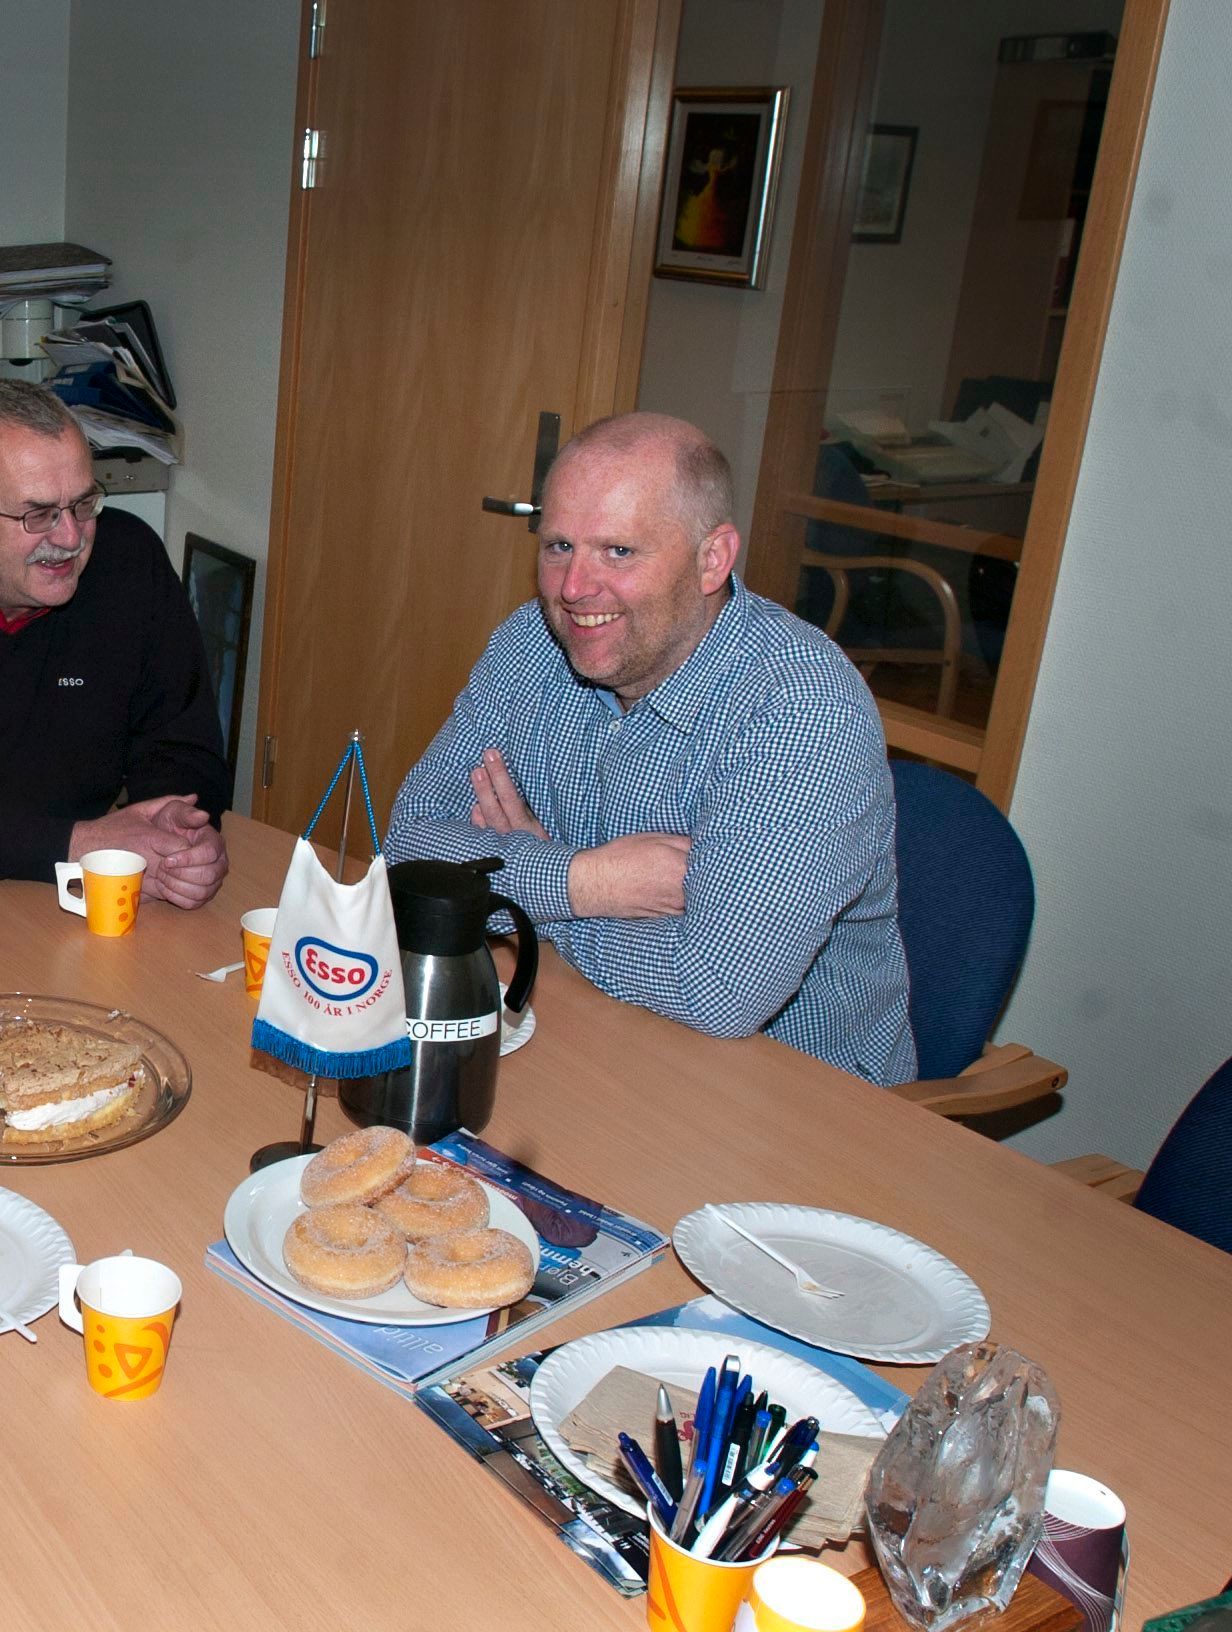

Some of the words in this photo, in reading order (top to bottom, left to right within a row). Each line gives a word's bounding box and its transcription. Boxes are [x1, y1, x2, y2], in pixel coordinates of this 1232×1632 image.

[281, 951, 301, 988] ESSO
[303, 991, 321, 1010] 100
[323, 1003, 343, 1016] ÅR
[347, 1006, 352, 1015] I
[356, 969, 393, 1013] NORGE
